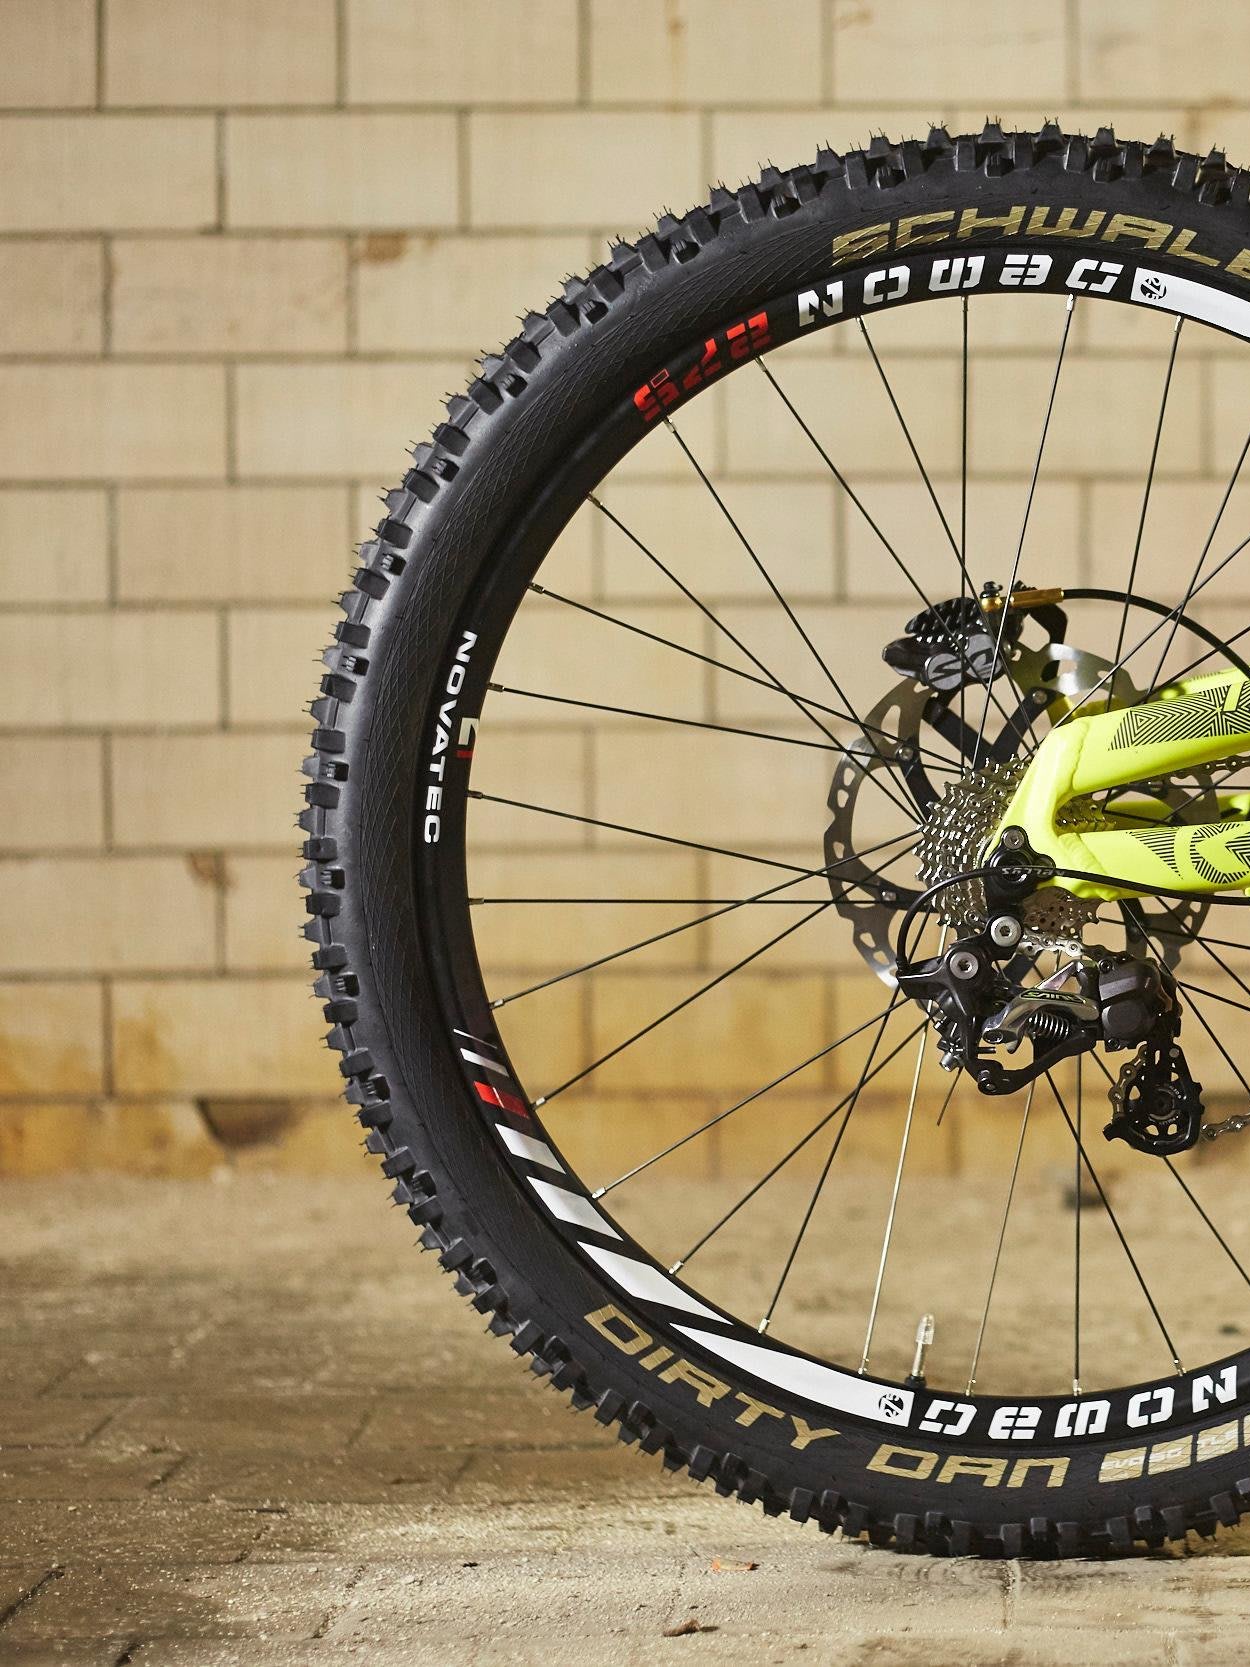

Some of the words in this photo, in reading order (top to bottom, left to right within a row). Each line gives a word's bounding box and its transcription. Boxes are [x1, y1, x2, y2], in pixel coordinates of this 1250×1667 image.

[424, 631, 478, 844] NOVATEC
[584, 1303, 842, 1451] DIRTY
[866, 1443, 1072, 1489] DAN
